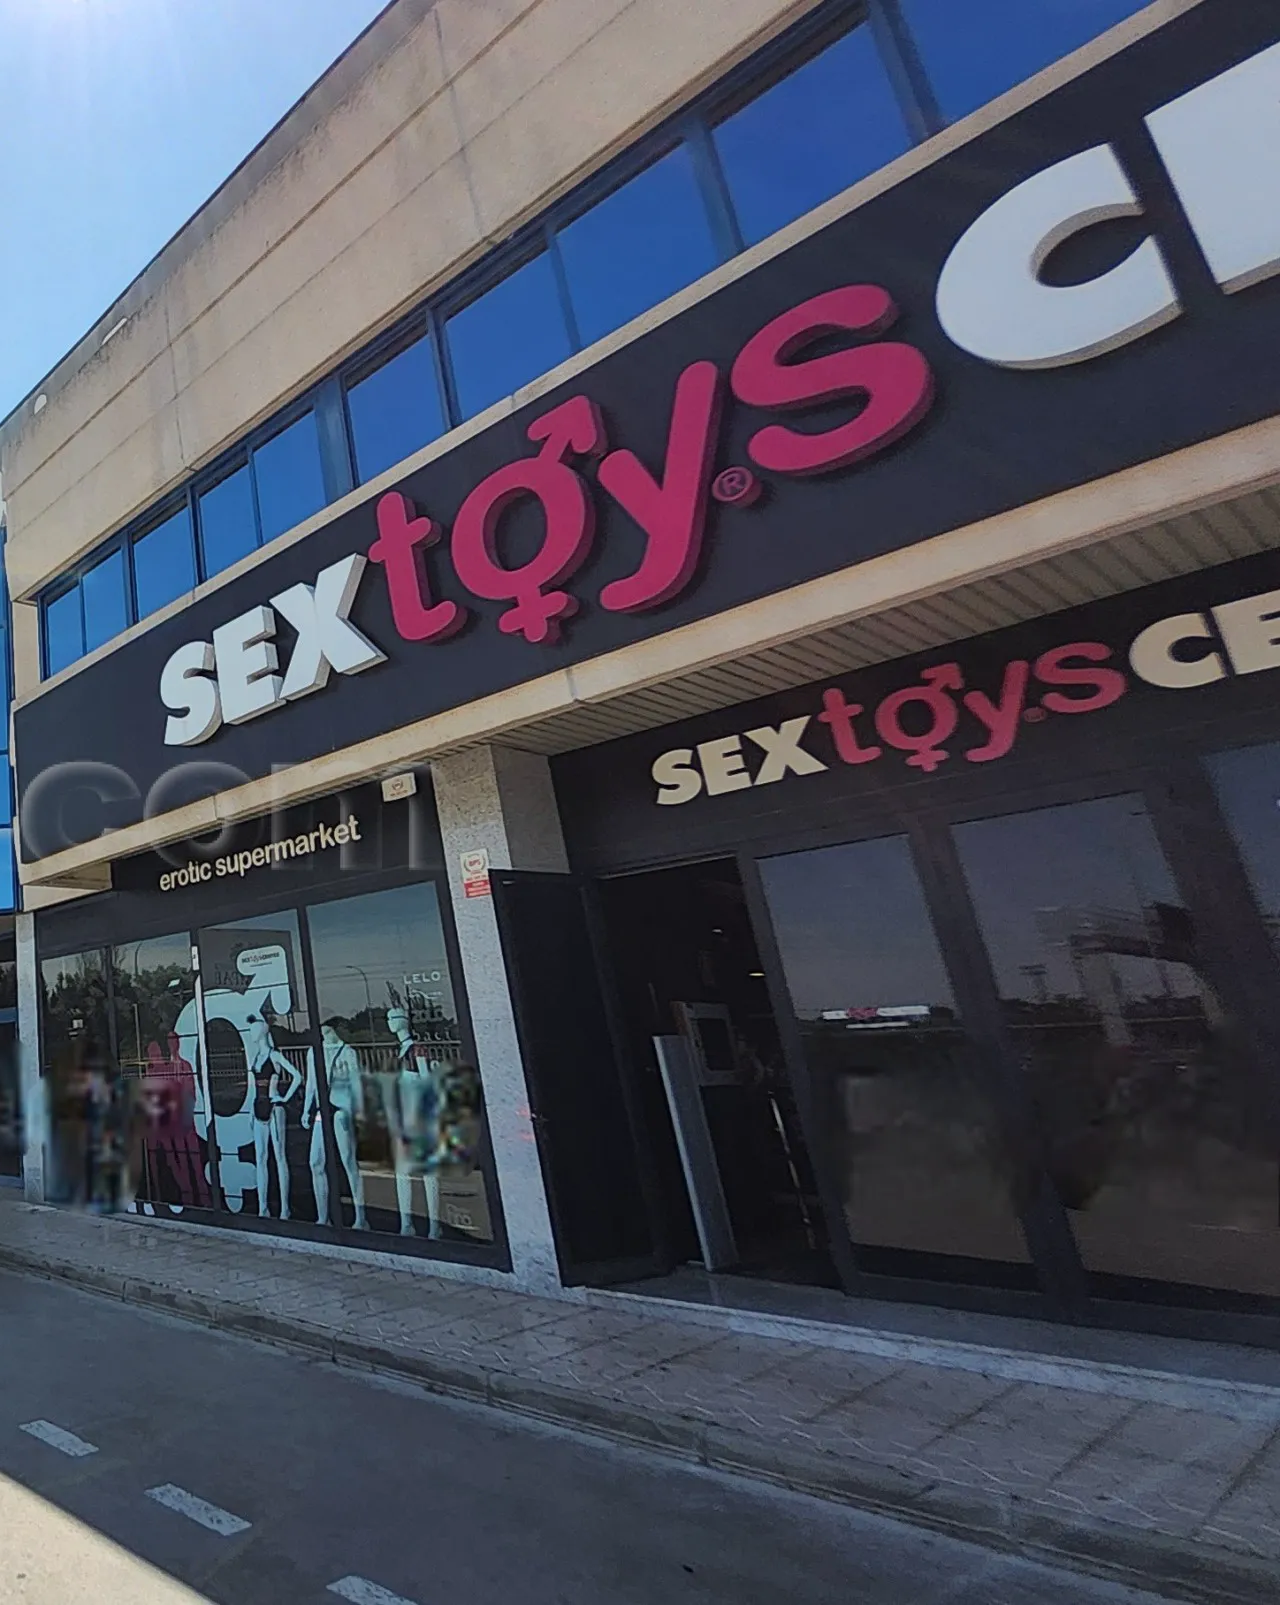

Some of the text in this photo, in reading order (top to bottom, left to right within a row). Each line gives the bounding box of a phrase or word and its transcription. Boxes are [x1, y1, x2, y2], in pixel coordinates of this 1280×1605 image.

[160, 552, 391, 748] SEX
[651, 715, 829, 805] SEX
[159, 814, 363, 892] erotic supermarket
[403, 971, 442, 985] LELO
